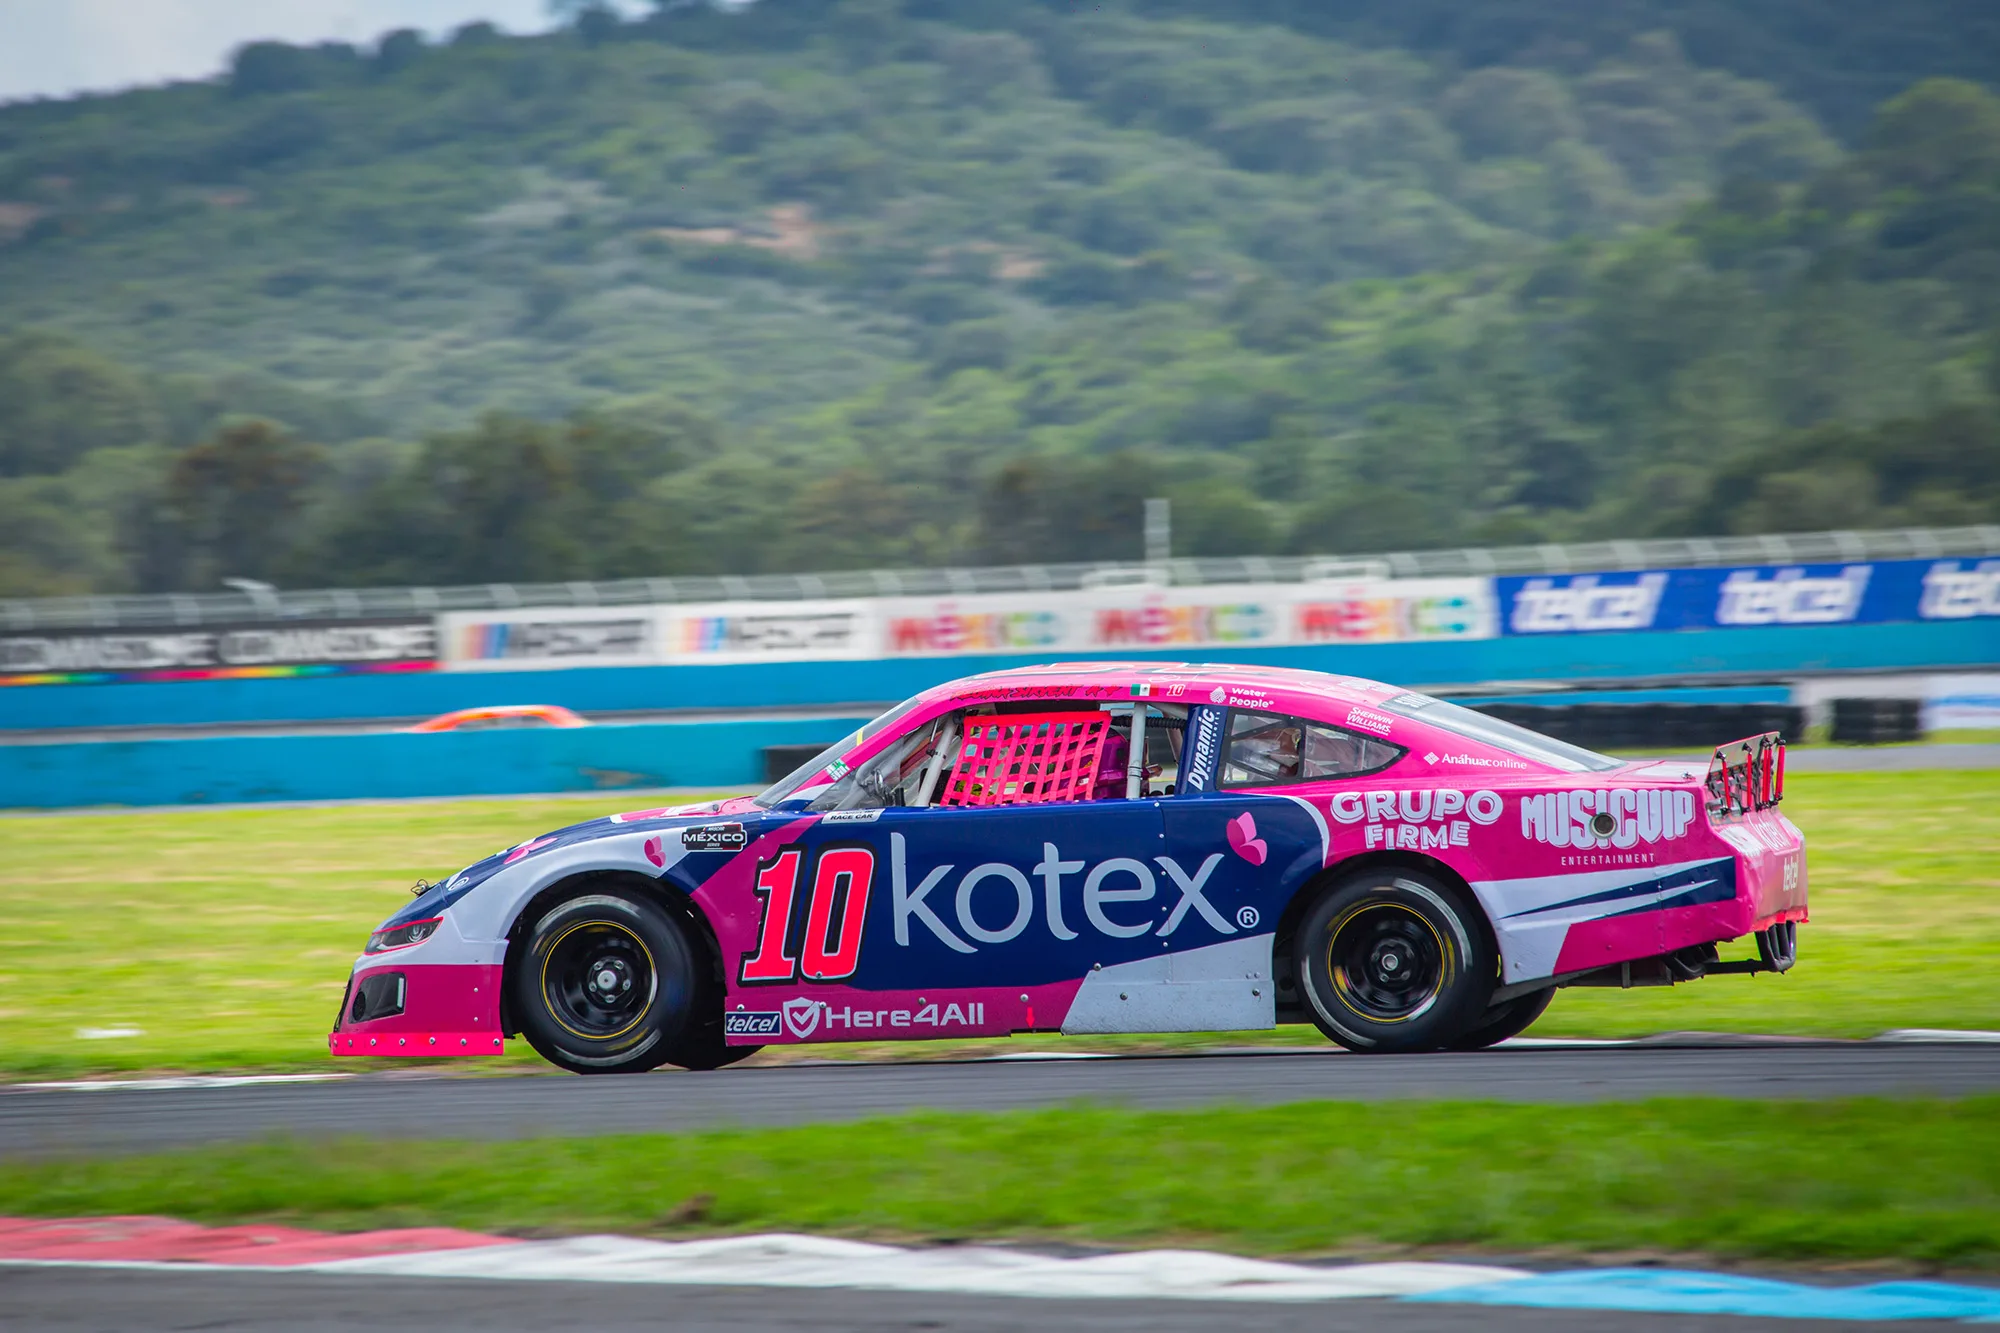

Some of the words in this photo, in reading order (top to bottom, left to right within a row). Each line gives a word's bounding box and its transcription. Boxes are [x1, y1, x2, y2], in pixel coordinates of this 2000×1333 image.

[1166, 683, 1186, 696] 10
[1231, 687, 1267, 698] Water
[1350, 706, 1394, 725] SHERWIN
[1187, 708, 1215, 791] Dynamic
[1441, 753, 1528, 770] Anáhuaconline
[1330, 788, 1504, 826] GRUPO
[683, 831, 744, 842] MÉXICO
[1364, 819, 1471, 851] FIRME
[1561, 852, 1656, 866] ENTERTAINMENT
[740, 846, 876, 983] 10
[726, 1013, 779, 1033] telcel
[825, 1002, 985, 1029] Here4All
